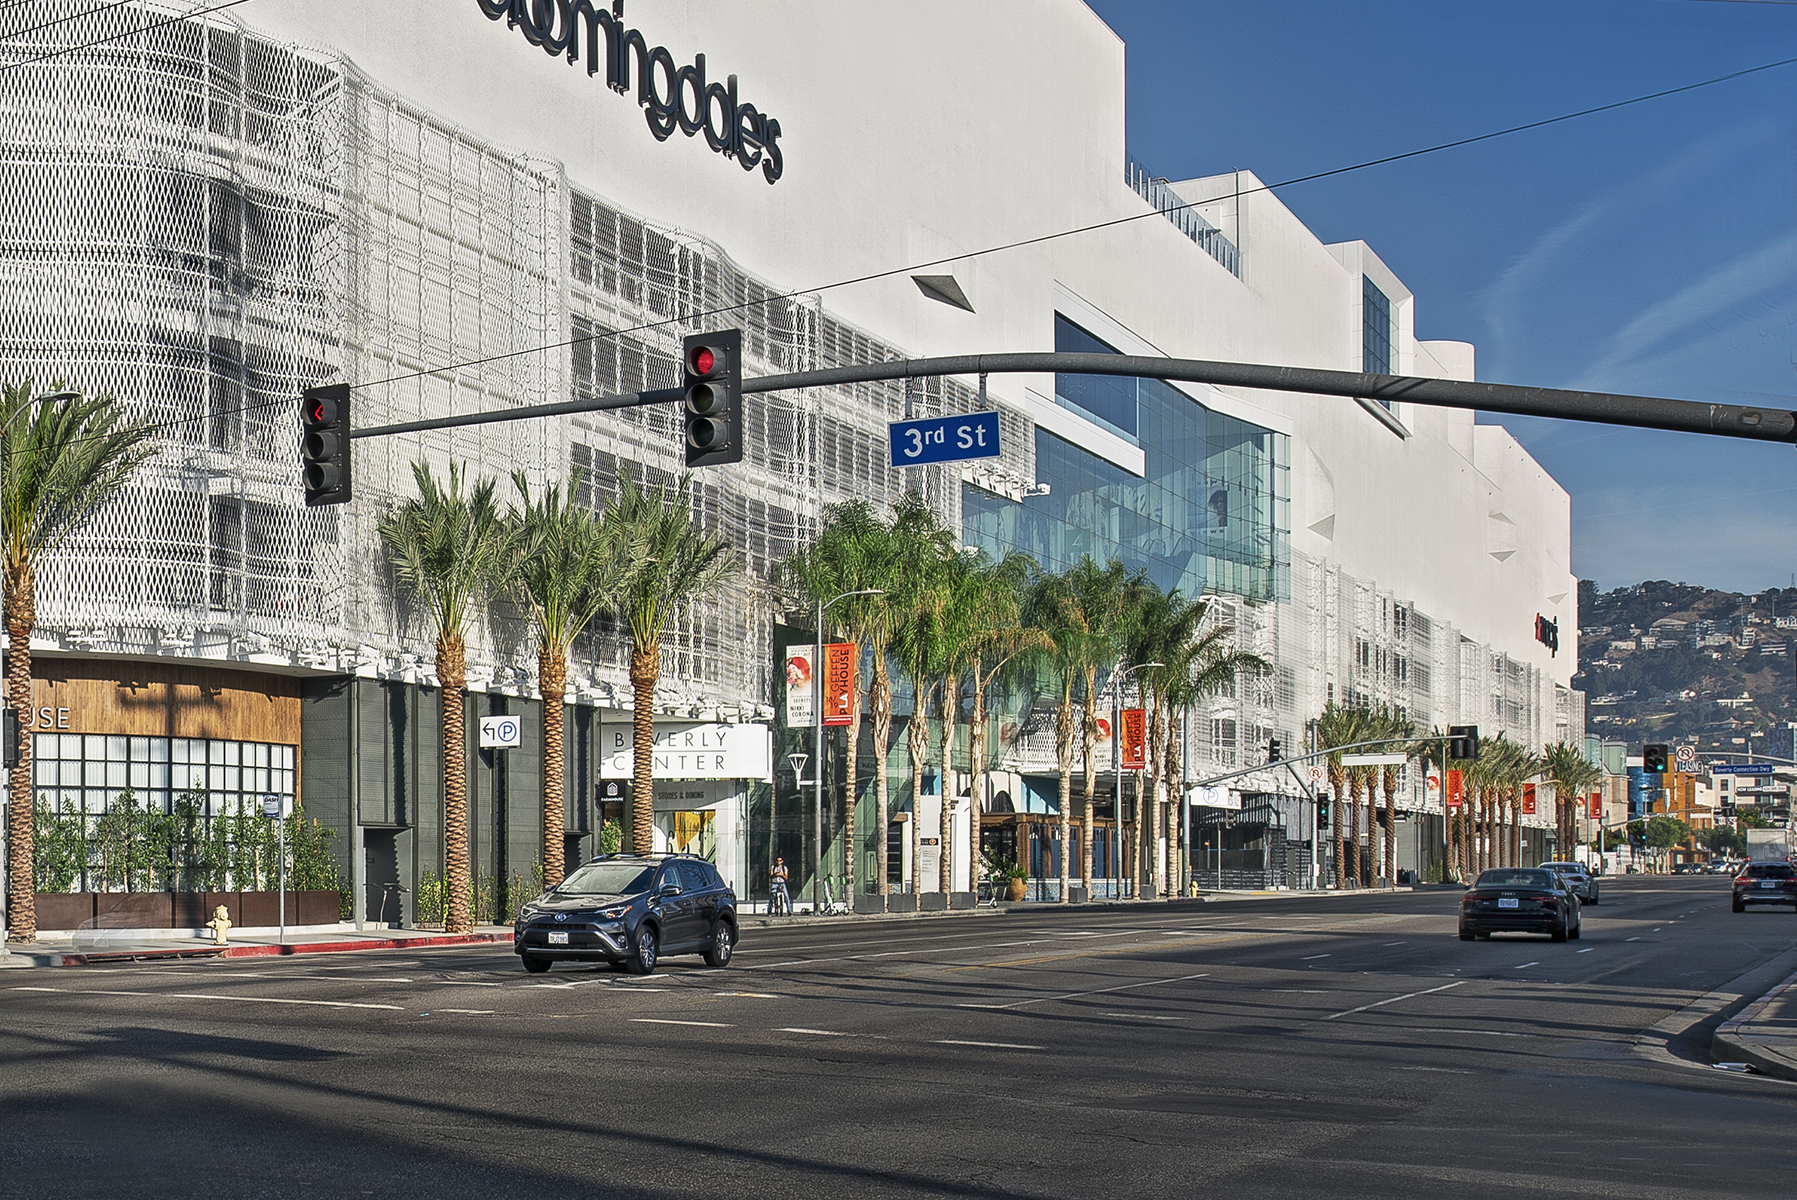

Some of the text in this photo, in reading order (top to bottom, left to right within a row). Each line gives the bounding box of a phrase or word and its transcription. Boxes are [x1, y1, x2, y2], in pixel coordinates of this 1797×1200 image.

[903, 424, 987, 458] 3rd St
[830, 649, 840, 692] GEFFEN
[838, 648, 850, 715] PLAYHOUSE
[615, 732, 726, 747] BVERLY
[1134, 713, 1142, 762] PLAYHOUSE
[613, 756, 725, 770] CNTER
